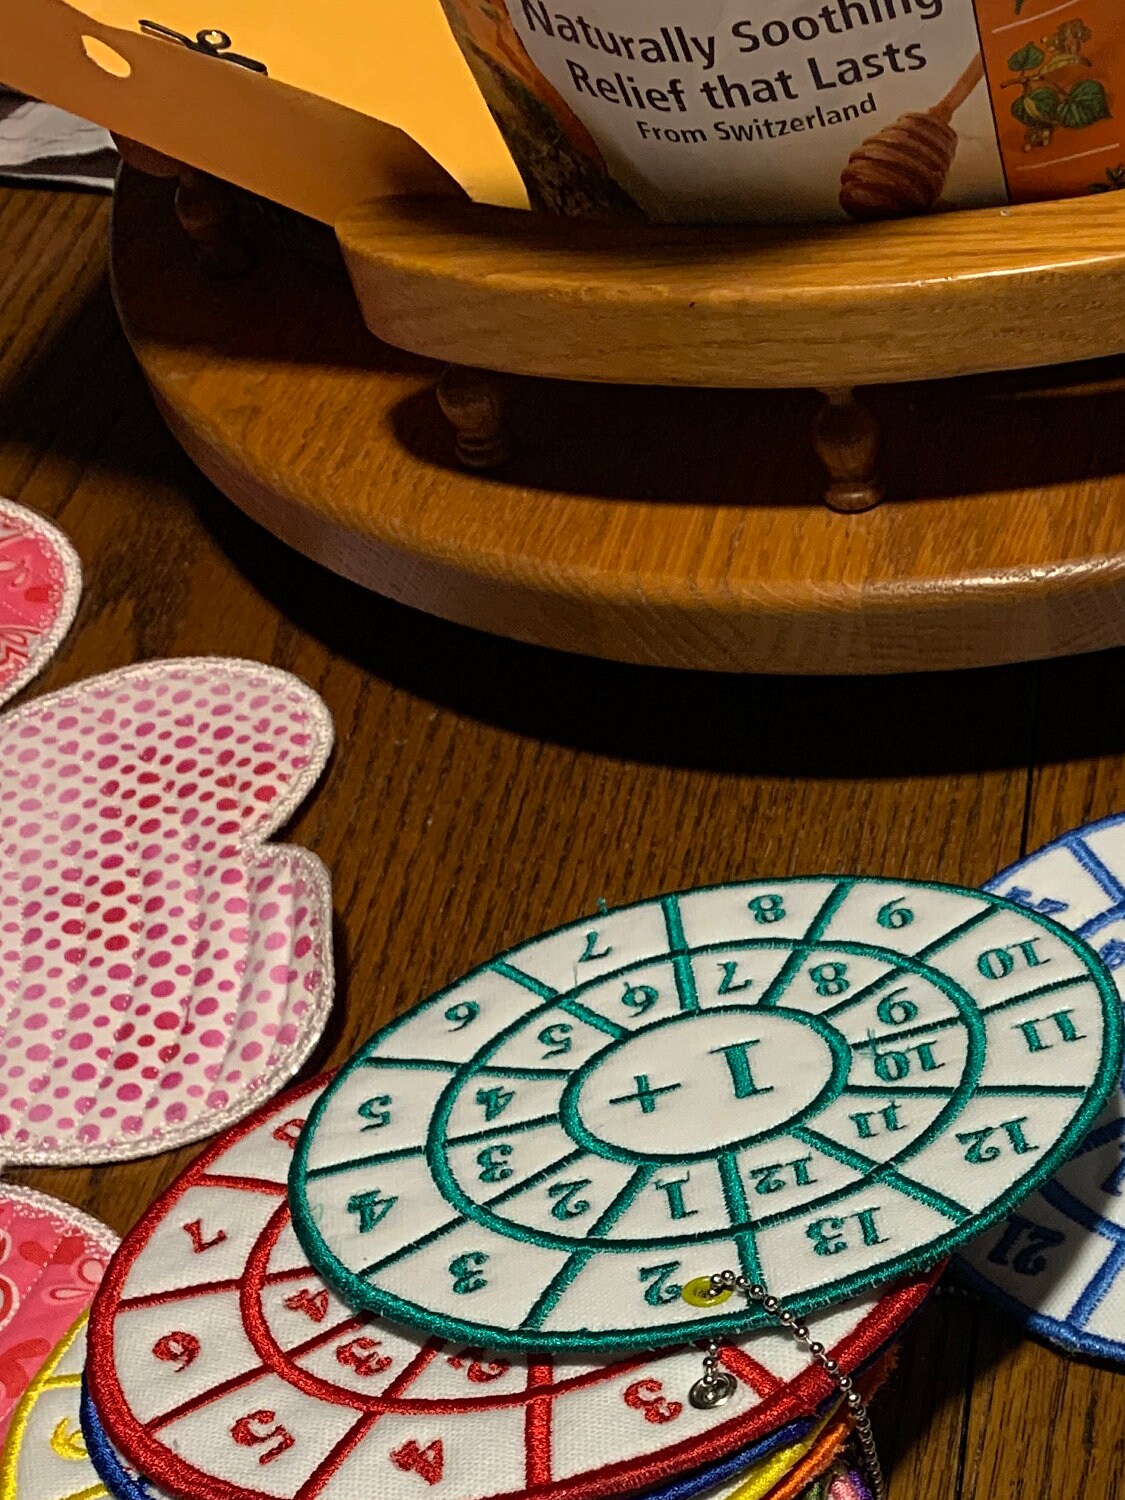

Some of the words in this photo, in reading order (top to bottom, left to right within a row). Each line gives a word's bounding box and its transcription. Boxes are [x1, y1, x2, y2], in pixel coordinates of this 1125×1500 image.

[522, 0, 716, 70] Naturally
[731, 0, 944, 53] Soothing
[565, 59, 685, 112] Relief
[700, 71, 799, 111] that
[807, 42, 928, 91] Lasts
[636, 120, 706, 144] From
[713, 93, 877, 143] Switzerland
[748, 893, 786, 924] 8
[579, 931, 612, 962] 7
[976, 937, 1051, 980] 10
[716, 961, 752, 995] 7
[809, 962, 850, 997] 8
[538, 1024, 573, 1058] 5
[1011, 1009, 1086, 1053] 11
[874, 1040, 946, 1082] 10
[358, 1095, 391, 1130] 5
[476, 1086, 515, 1121] 4
[849, 1101, 907, 1138] 11
[956, 1116, 1040, 1164] 12
[477, 1144, 513, 1183] 3
[750, 1156, 818, 1195] 12
[347, 1190, 398, 1233] 4
[548, 1179, 591, 1220] 2
[656, 1171, 698, 1219] 1
[183, 1219, 227, 1253] 7
[806, 1206, 890, 1256] 13
[989, 1213, 1066, 1276] 21
[449, 1252, 489, 1294] 3
[639, 1260, 682, 1305] 2
[284, 1287, 329, 1323] 4
[336, 1337, 393, 1376] 3
[623, 1379, 683, 1425] 3
[230, 1410, 295, 1466] 5
[390, 1439, 444, 1486] 4
